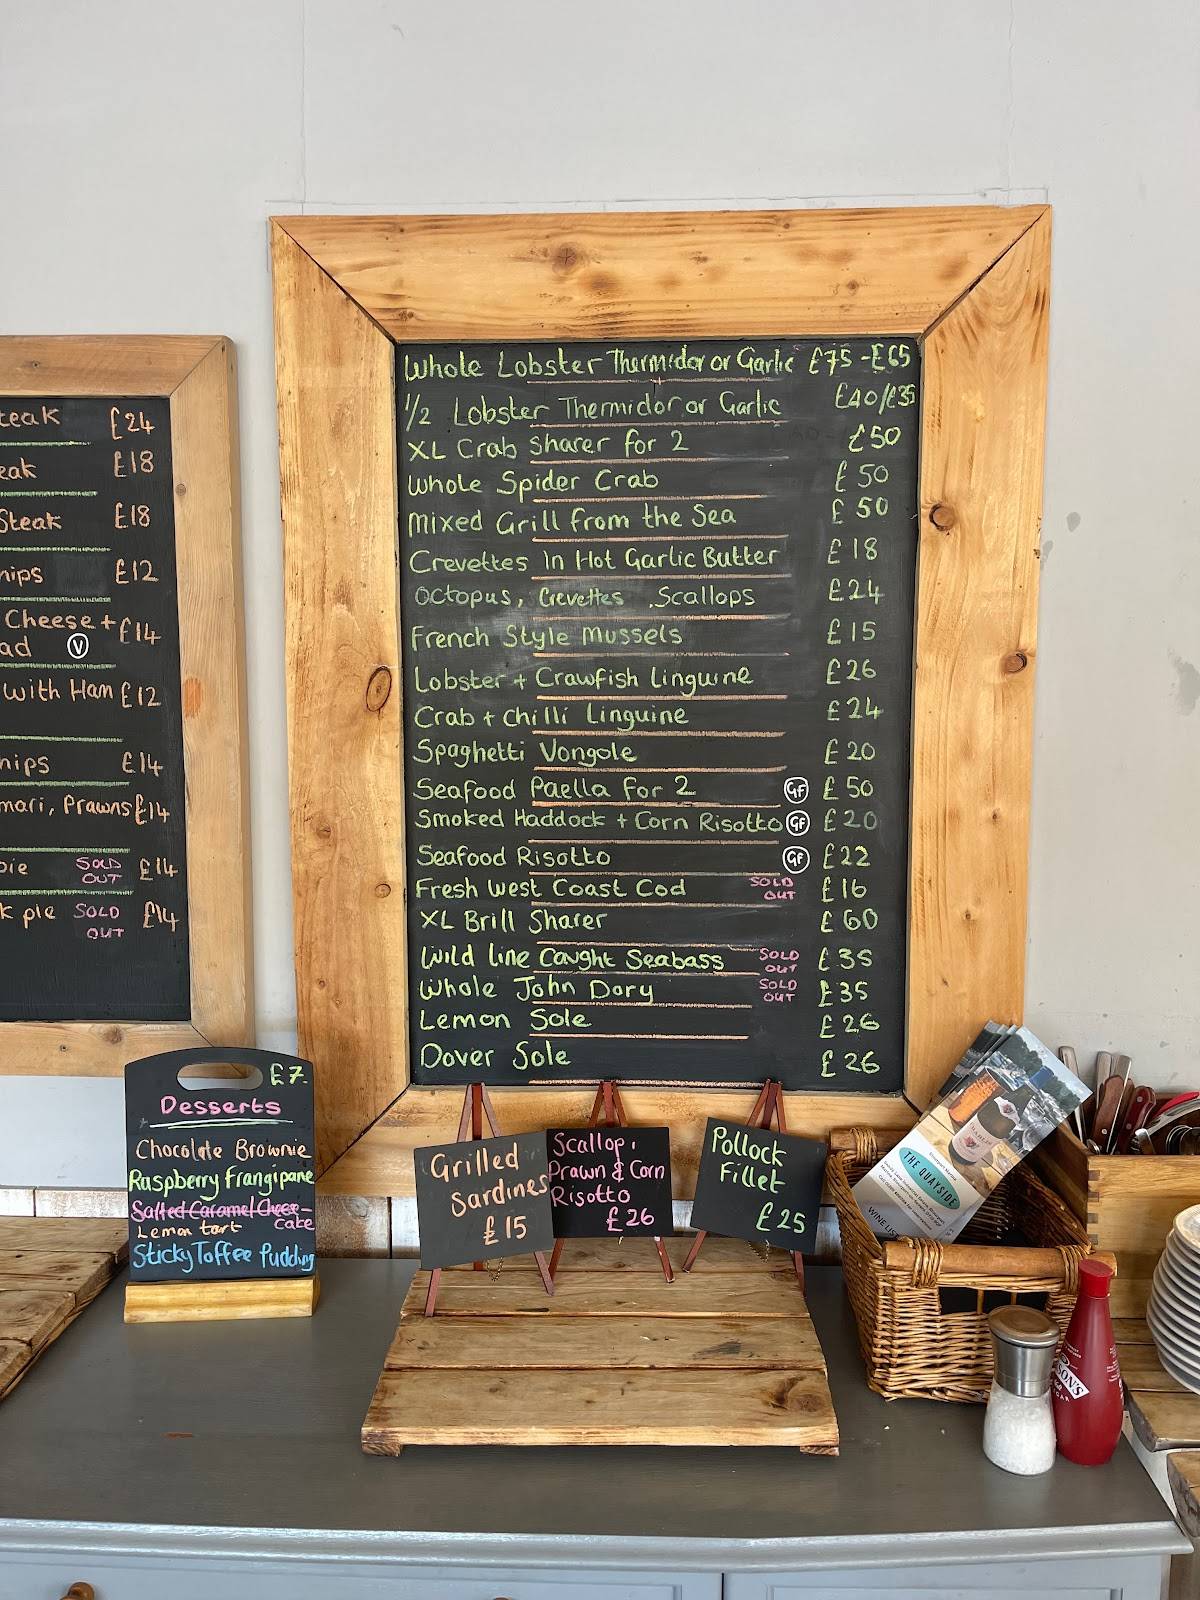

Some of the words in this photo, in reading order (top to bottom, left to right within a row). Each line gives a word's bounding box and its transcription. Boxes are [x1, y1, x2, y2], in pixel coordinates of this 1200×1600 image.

[404, 350, 484, 382] Whole
[498, 347, 603, 378] Lobster
[711, 352, 730, 372] or
[736, 346, 794, 374] Garlic
[453, 395, 550, 426] Lobster
[557, 392, 681, 420] Thermidor
[685, 397, 708, 416] or
[719, 389, 782, 417] Garlic
[408, 440, 447, 461] XL
[457, 436, 518, 459] Crab
[671, 429, 690, 451] 2
[496, 469, 580, 503] Spider
[595, 468, 659, 491] Crab
[496, 510, 560, 535] Grill
[642, 502, 683, 529] the
[692, 503, 736, 527] Sea
[409, 550, 529, 574] Crevettes
[576, 549, 616, 571] Hot
[624, 545, 697, 569] Garlic
[703, 546, 781, 568] Butter
[4, 608, 96, 629] Cheese
[412, 626, 490, 651] French
[503, 624, 571, 651] Style
[414, 666, 507, 693] Lobster
[535, 667, 638, 690] Crawfish
[414, 705, 474, 728] Crab
[412, 738, 525, 768] Spaghetti
[539, 738, 638, 767] Vongole
[413, 777, 517, 804] Seafood
[530, 776, 611, 800] Paella
[675, 775, 696, 796] 2
[63, 794, 132, 817] Prawns
[414, 808, 504, 829] Smoked
[514, 809, 606, 828] Haddock
[635, 810, 689, 832] Corn
[699, 812, 783, 832] Risotto
[416, 844, 506, 867] Seafood
[517, 846, 611, 867] Risotto
[415, 877, 479, 899] Fresh
[552, 878, 627, 897] Coast
[636, 878, 687, 897] Cod
[750, 876, 794, 887] SOLD
[764, 890, 796, 900] OUT
[73, 903, 120, 919] SOLD
[420, 910, 454, 929] XL
[464, 908, 516, 933] Brill
[528, 908, 608, 934] Sharer
[87, 927, 125, 940] OUT
[421, 944, 475, 970] Wild
[539, 948, 616, 971] Caught
[626, 949, 724, 970] Seabass
[759, 947, 800, 960] SOLD
[765, 963, 798, 974] OUT
[419, 974, 497, 1000] Whole
[514, 974, 576, 1001] John
[591, 979, 654, 1005] Dory
[759, 978, 798, 990] SOLD
[763, 992, 795, 1002] OUT
[419, 1009, 511, 1031] Lemon
[530, 1008, 593, 1031] Sole
[421, 1042, 494, 1069] Dover
[512, 1040, 571, 1070] Sole
[160, 1095, 282, 1116] Desserts
[135, 1138, 223, 1161] Chocolate
[234, 1138, 312, 1161] Brownie
[712, 1126, 787, 1167] Pollock
[430, 1142, 519, 1182] Grilled
[548, 1160, 606, 1182] Prawn
[629, 1160, 665, 1180] Corn
[128, 1168, 219, 1201] Raspberry
[720, 1161, 786, 1194] Fillet
[904, 1151, 920, 1169] THE
[919, 1167, 957, 1207] QUAYSIDE
[451, 1174, 548, 1218] Sardines
[551, 1183, 631, 1207] Risotto
[868, 1206, 887, 1227] WINE
[884, 1224, 900, 1240] LIST
[133, 1242, 193, 1274] Sticky
[191, 1240, 252, 1265] Toffee
[259, 1243, 315, 1271] Pudding
